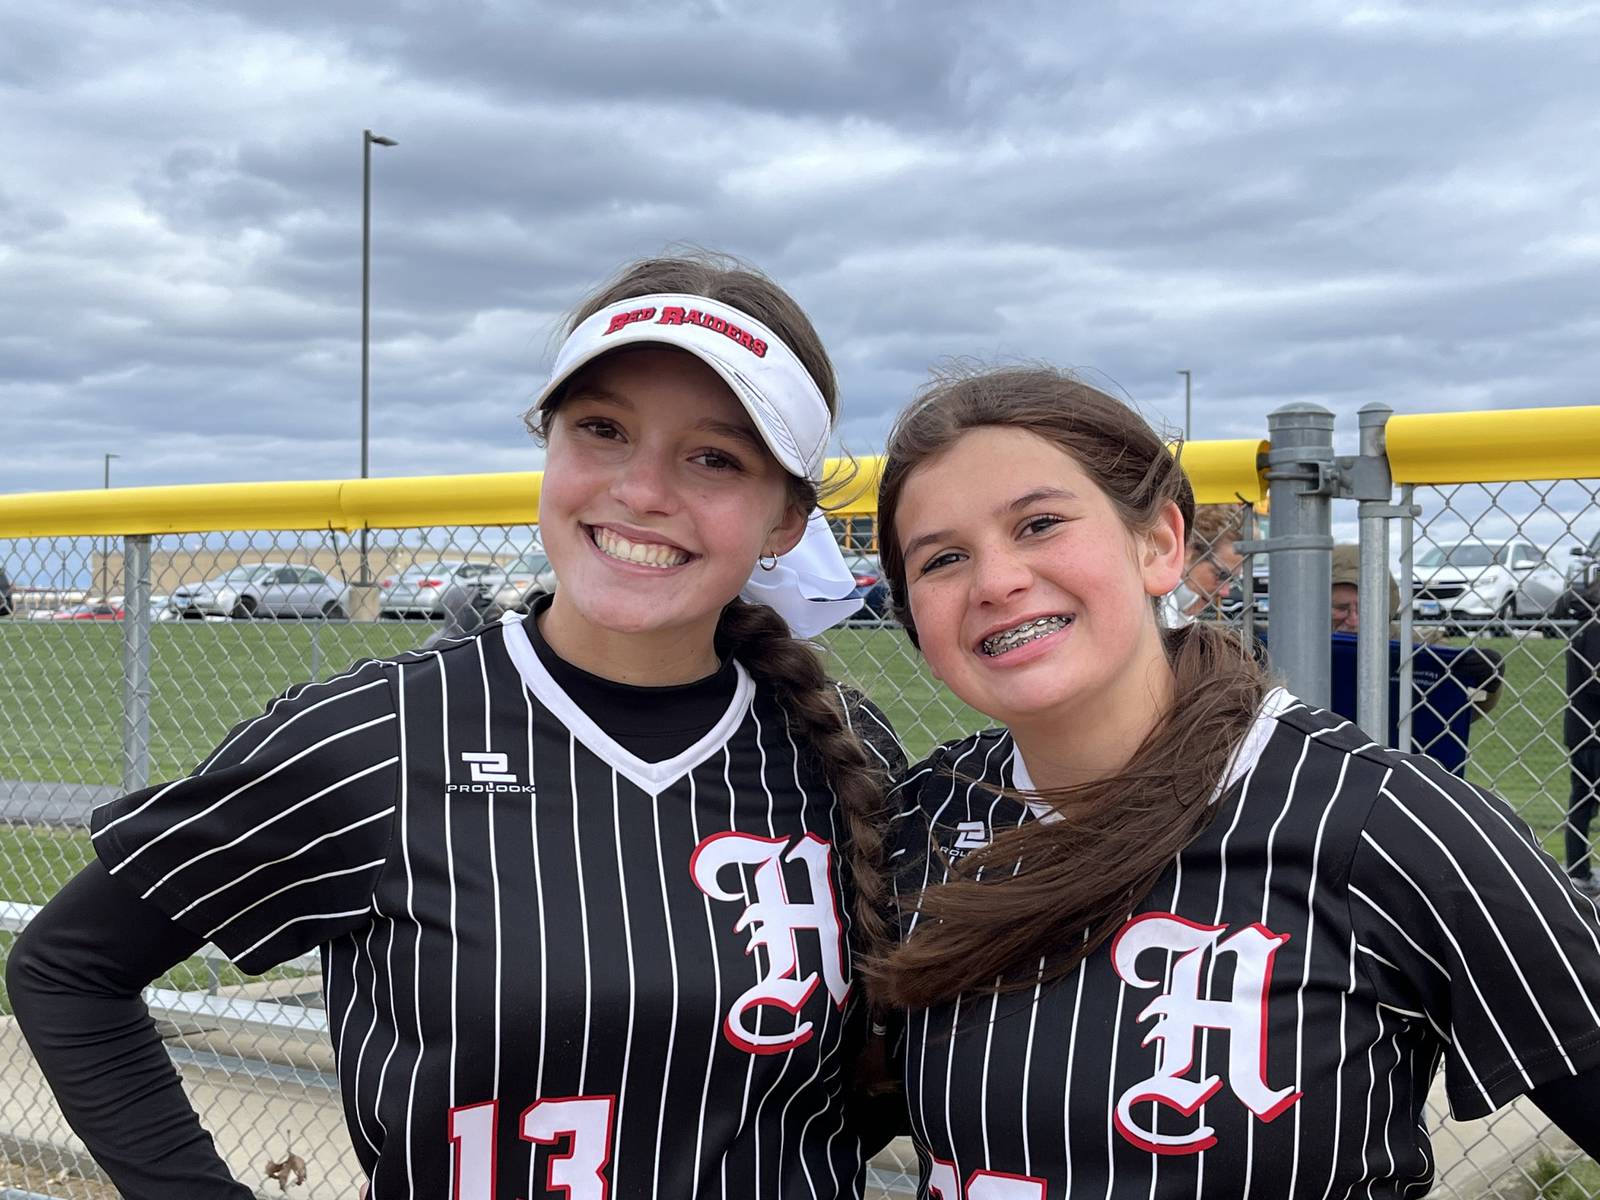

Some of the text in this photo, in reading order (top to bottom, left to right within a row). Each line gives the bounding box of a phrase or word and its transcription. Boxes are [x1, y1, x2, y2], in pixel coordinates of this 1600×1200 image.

[602, 306, 768, 358] RED RAIDERS
[447, 784, 536, 793] PROLOOK
[448, 1095, 616, 1200] 13
